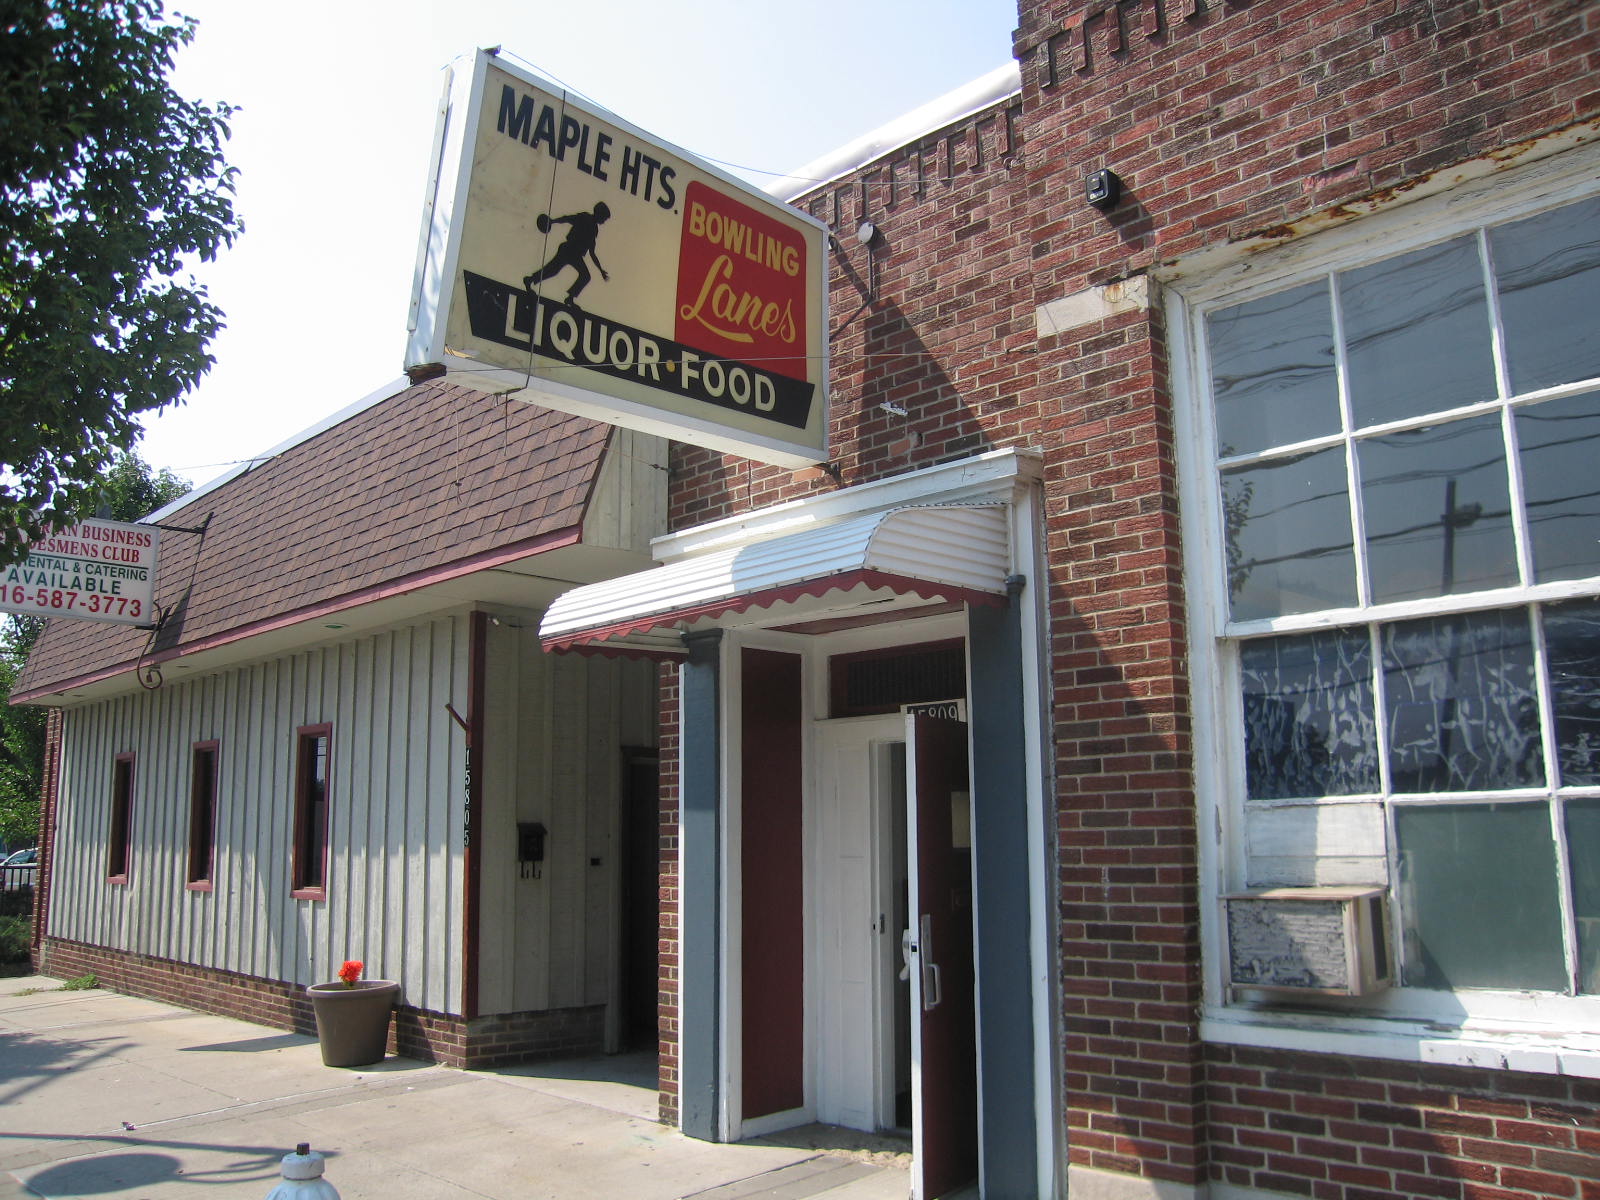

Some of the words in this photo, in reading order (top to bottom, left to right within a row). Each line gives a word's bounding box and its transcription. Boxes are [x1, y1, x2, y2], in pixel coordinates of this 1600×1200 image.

[497, 84, 612, 182] MAPLE
[620, 146, 678, 215] HTS.
[689, 201, 800, 277] BOWLING
[680, 256, 797, 344] Lanes
[505, 294, 660, 381] LIQUOR
[681, 350, 777, 412] FOOD
[82, 524, 152, 548] BUSINESS
[102, 546, 140, 563] CLUB
[8, 568, 122, 595] AVAILABLE
[73, 561, 81, 573] &
[85, 563, 148, 581] CATERING
